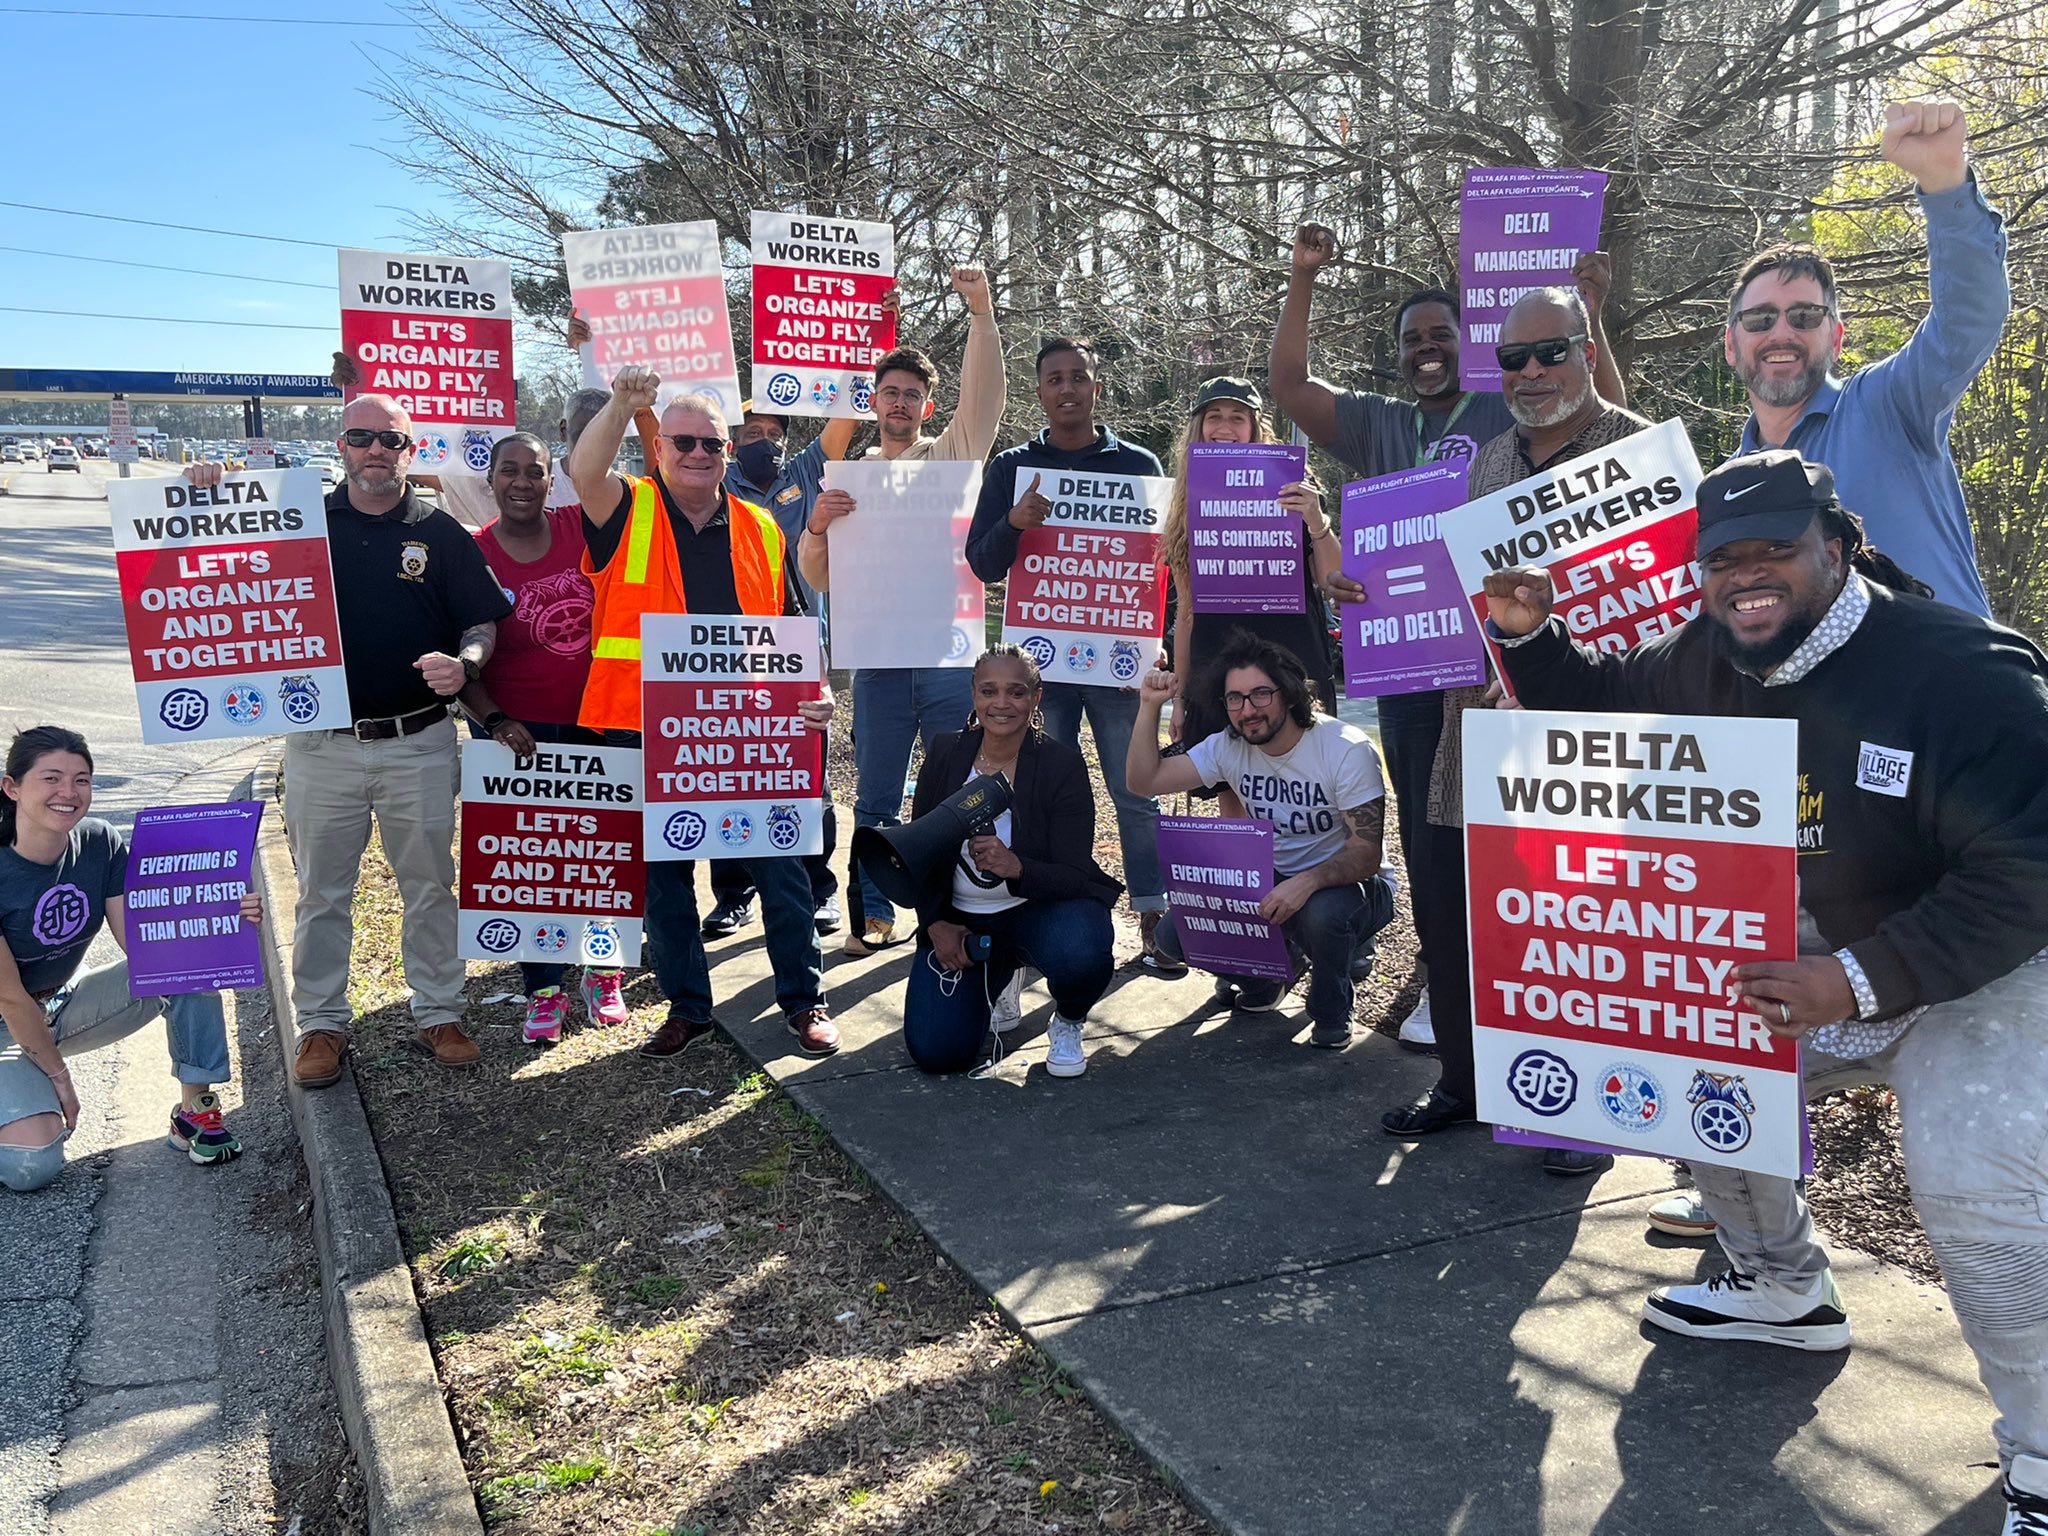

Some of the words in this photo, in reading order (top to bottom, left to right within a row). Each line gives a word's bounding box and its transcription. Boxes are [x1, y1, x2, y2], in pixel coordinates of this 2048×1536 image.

[1467, 188, 1489, 197] DELTA
[1505, 187, 1530, 195] FLIGHT
[1531, 185, 1579, 193] ATTENDANTS
[790, 222, 858, 244] DELTA
[1504, 212, 1549, 234] DELTA
[768, 242, 880, 268] WORKERS
[1475, 249, 1579, 272] MANAGEMENT
[387, 261, 469, 285] DELTA
[794, 274, 856, 297] LET'S
[359, 285, 496, 311] WORKERS
[765, 295, 882, 321] ORGANIZE
[1467, 288, 1495, 308] HAS
[392, 319, 466, 342] LET'S
[777, 319, 825, 338] AND
[832, 323, 872, 346] FLY,
[1470, 324, 1502, 343] WHY
[358, 343, 500, 369] ORGANIZE
[763, 340, 885, 365] TOGETHER
[174, 373, 232, 385] AMERICA'S
[234, 375, 264, 386] MOST
[267, 376, 319, 387] AWARDED
[373, 369, 431, 390] AND
[439, 372, 487, 397] FLY,
[356, 393, 504, 418] GETHER
[1059, 478, 1135, 500] DELTA
[1226, 470, 1264, 487] DELTA
[1347, 488, 1366, 497] DELTA
[1367, 484, 1380, 493] AFA
[1381, 479, 1404, 490] FLIGHT
[1405, 468, 1447, 484] ATTENDANTS
[165, 481, 268, 508] DELTA
[1506, 457, 1631, 526] DELTA
[134, 508, 303, 540] WORKERS
[1047, 502, 1157, 526] ORKERS
[1480, 476, 1682, 570] WORKERS
[1057, 533, 1126, 555] LET'S
[1194, 530, 1218, 546] HAS
[1222, 531, 1296, 548] CONTRACTS,
[1354, 524, 1387, 556] PRO
[178, 551, 271, 579] LET'S
[1024, 555, 1155, 582] ORGANIZE
[1197, 559, 1224, 575] WHY
[1228, 560, 1265, 575] DON'T
[1268, 560, 1296, 576] WE?
[140, 577, 315, 611] ORGANIZE
[1034, 580, 1088, 600] AND
[1095, 584, 1140, 608] FLY,
[162, 615, 232, 640] AND
[242, 608, 303, 635] FLY,
[1018, 602, 1154, 629] TOGETHER
[1360, 617, 1399, 647] PRO
[1404, 607, 1464, 642] DELTA
[691, 625, 776, 646] DELTA
[144, 636, 327, 671] TOGETHER
[662, 653, 803, 673] WORKERS
[696, 689, 772, 711] LET'S
[660, 716, 806, 738] ORGANIZE
[515, 752, 605, 775] DELTA
[674, 744, 734, 765] AND
[743, 743, 793, 768] FLY,
[1546, 729, 1706, 773] DELTA
[1859, 753, 1907, 784] VILLAGE
[483, 776, 633, 802] WORKERS
[656, 770, 810, 793] TOGETHER
[1240, 774, 1329, 807] GEORGIA
[1497, 775, 1761, 827] WORKERS
[140, 815, 161, 823] DELTA
[199, 809, 240, 818] ATTENDANTS
[516, 812, 597, 834] LET'S
[1160, 821, 1179, 829] DELTA
[1214, 823, 1254, 831] ATTENDANTS
[478, 835, 632, 860] ORGANIZE
[139, 851, 220, 876] EVERYTHING
[224, 850, 238, 868] IS
[491, 861, 554, 881] AND
[563, 864, 616, 888] FLY,
[1555, 844, 1697, 892] LET'S
[1171, 864, 1243, 887] EVERYTHING
[1247, 870, 1260, 888] IS
[128, 890, 170, 909] GOING
[174, 886, 191, 905] UP
[196, 881, 246, 903] FASTER
[473, 884, 632, 909] TOGETHER
[1169, 891, 1203, 907] GOING
[1206, 895, 1222, 911] UP
[1226, 898, 1262, 916] FASTE
[139, 920, 175, 942] THAN
[180, 918, 209, 938] OUR
[212, 915, 240, 935] PAY
[1184, 916, 1216, 933] THAN
[1219, 920, 1244, 935] OUR
[1246, 924, 1270, 939] PAY
[1495, 888, 1767, 950] ORGANIZE
[1521, 938, 1626, 984] AND
[1643, 951, 1740, 1003] FLY,
[1493, 980, 1774, 1053] TOGETHER
